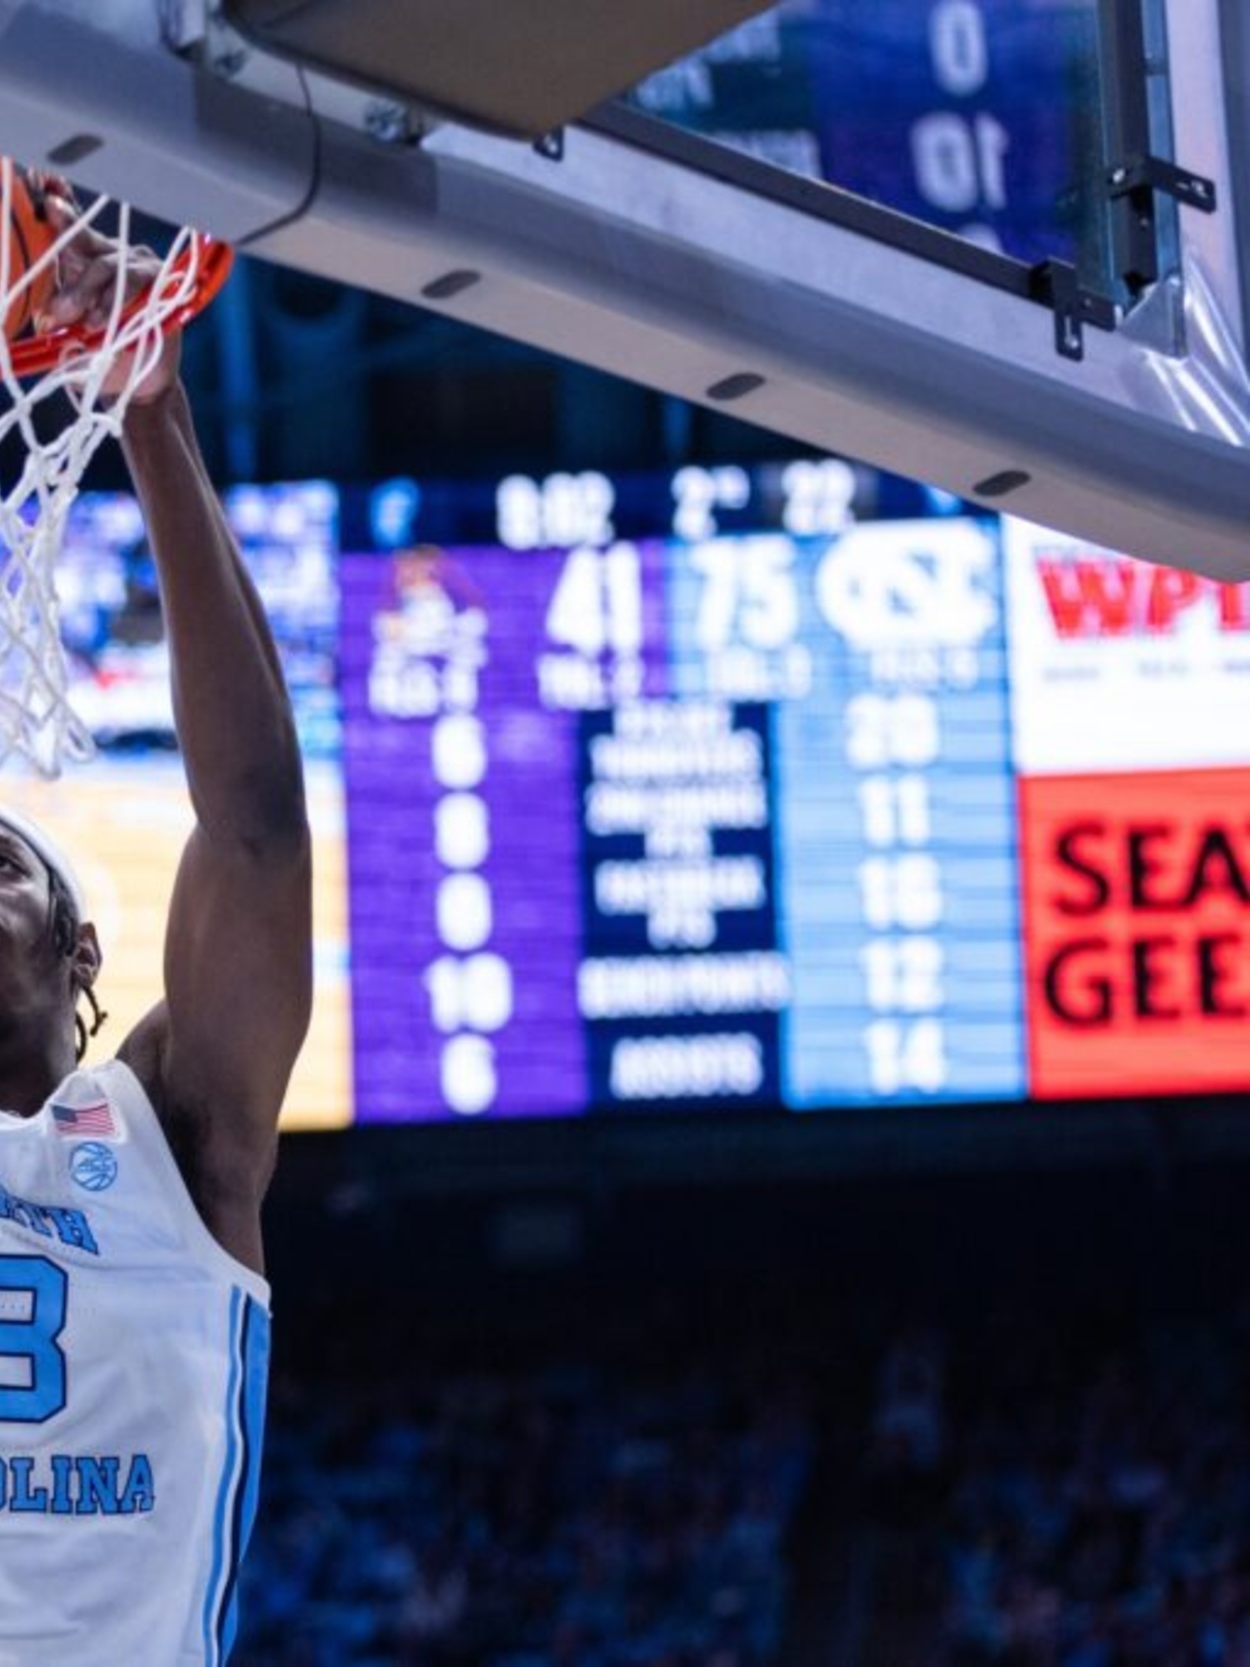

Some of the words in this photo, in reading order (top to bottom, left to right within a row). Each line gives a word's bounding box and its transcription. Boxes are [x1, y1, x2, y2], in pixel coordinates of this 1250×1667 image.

[547, 540, 642, 653] 41
[690, 534, 798, 650] 75
[1054, 824, 1250, 916] SEA
[1044, 936, 1248, 1028] GEE
[866, 1017, 945, 1094] 14
